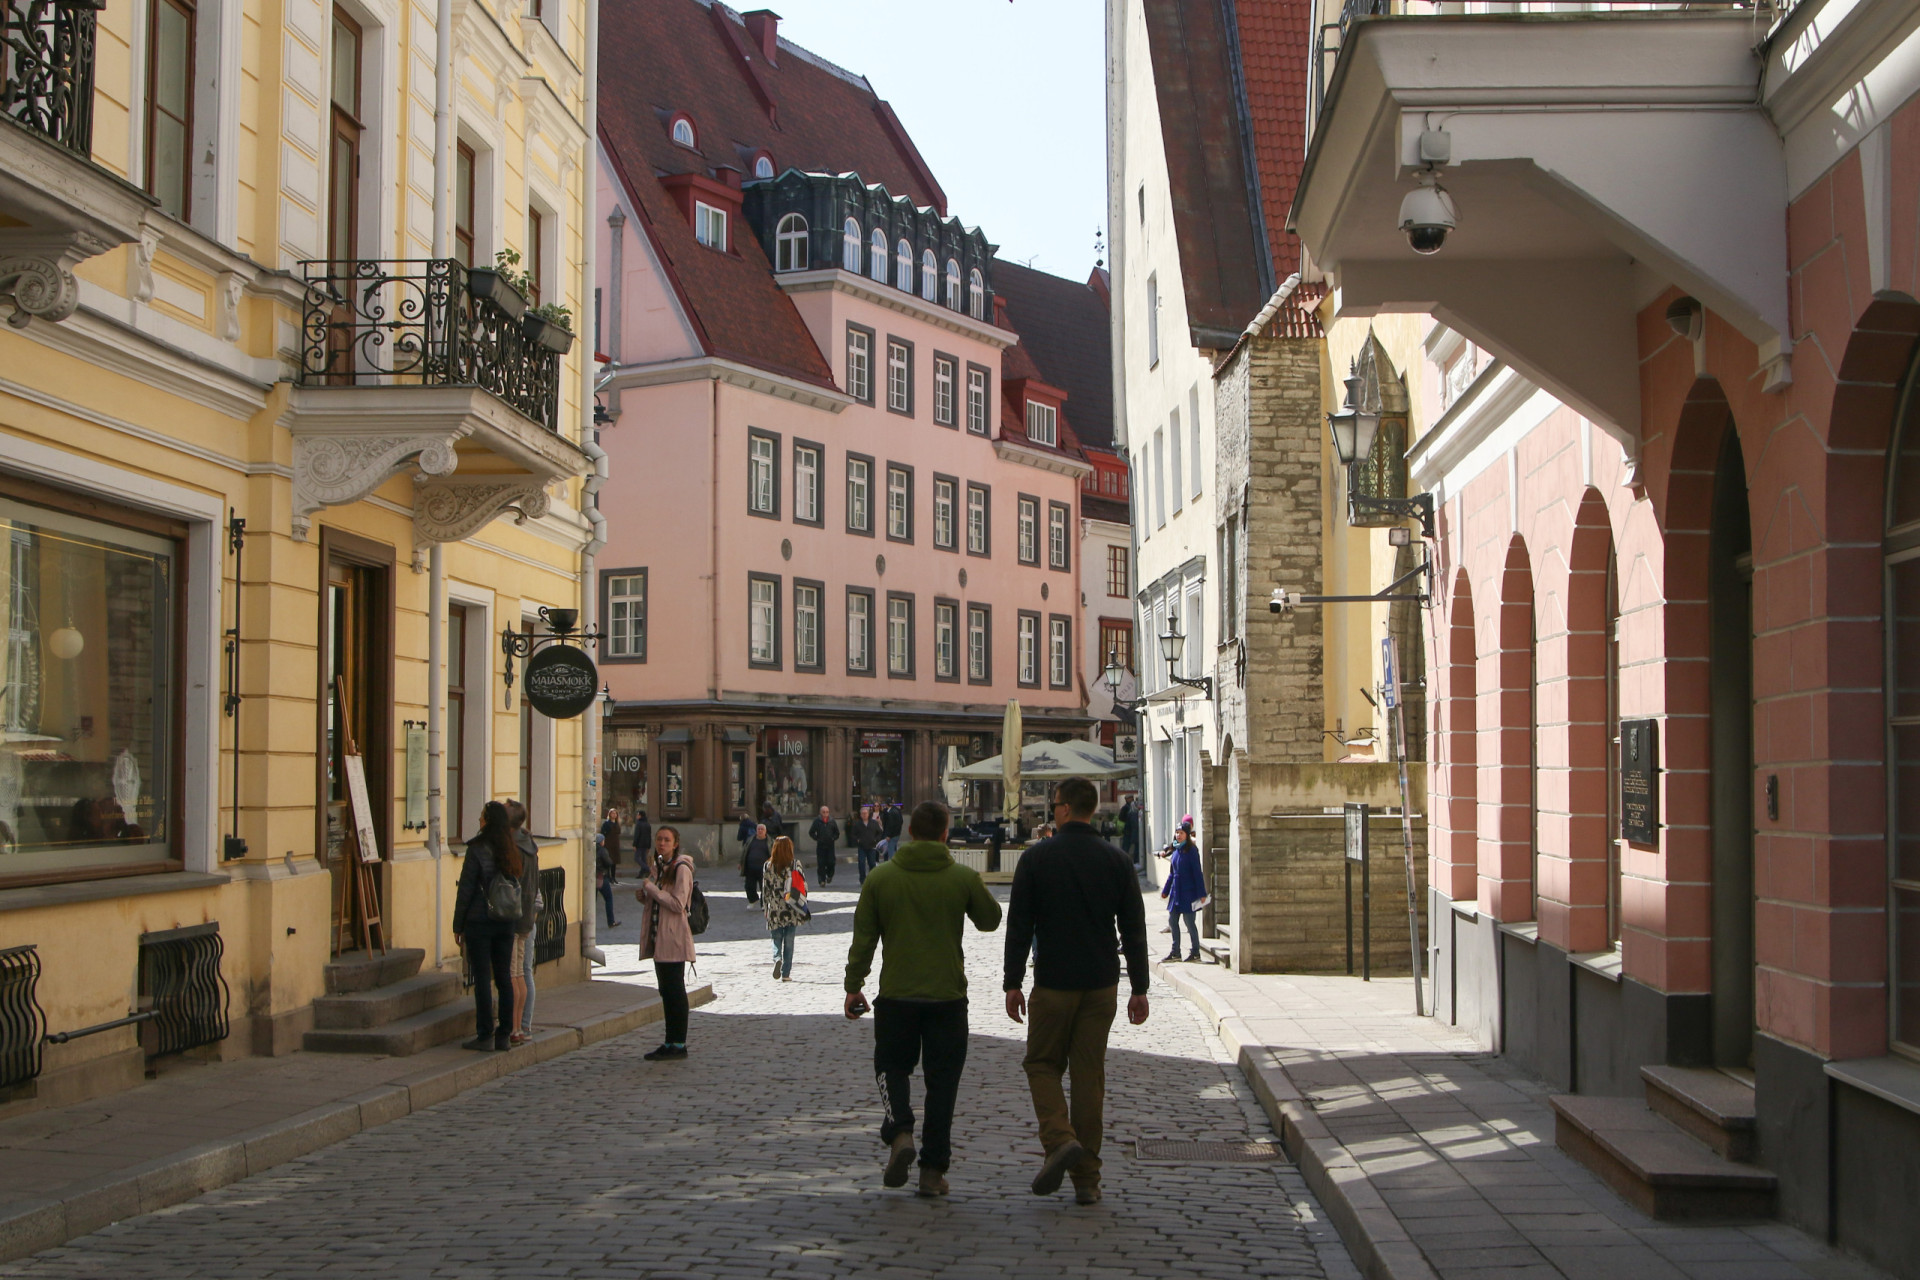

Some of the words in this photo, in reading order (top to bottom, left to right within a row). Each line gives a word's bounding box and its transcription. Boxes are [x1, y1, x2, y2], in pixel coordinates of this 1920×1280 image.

[531, 676, 591, 686] MAIASMOKK
[778, 734, 803, 756] LINO
[604, 750, 640, 772] LINO
